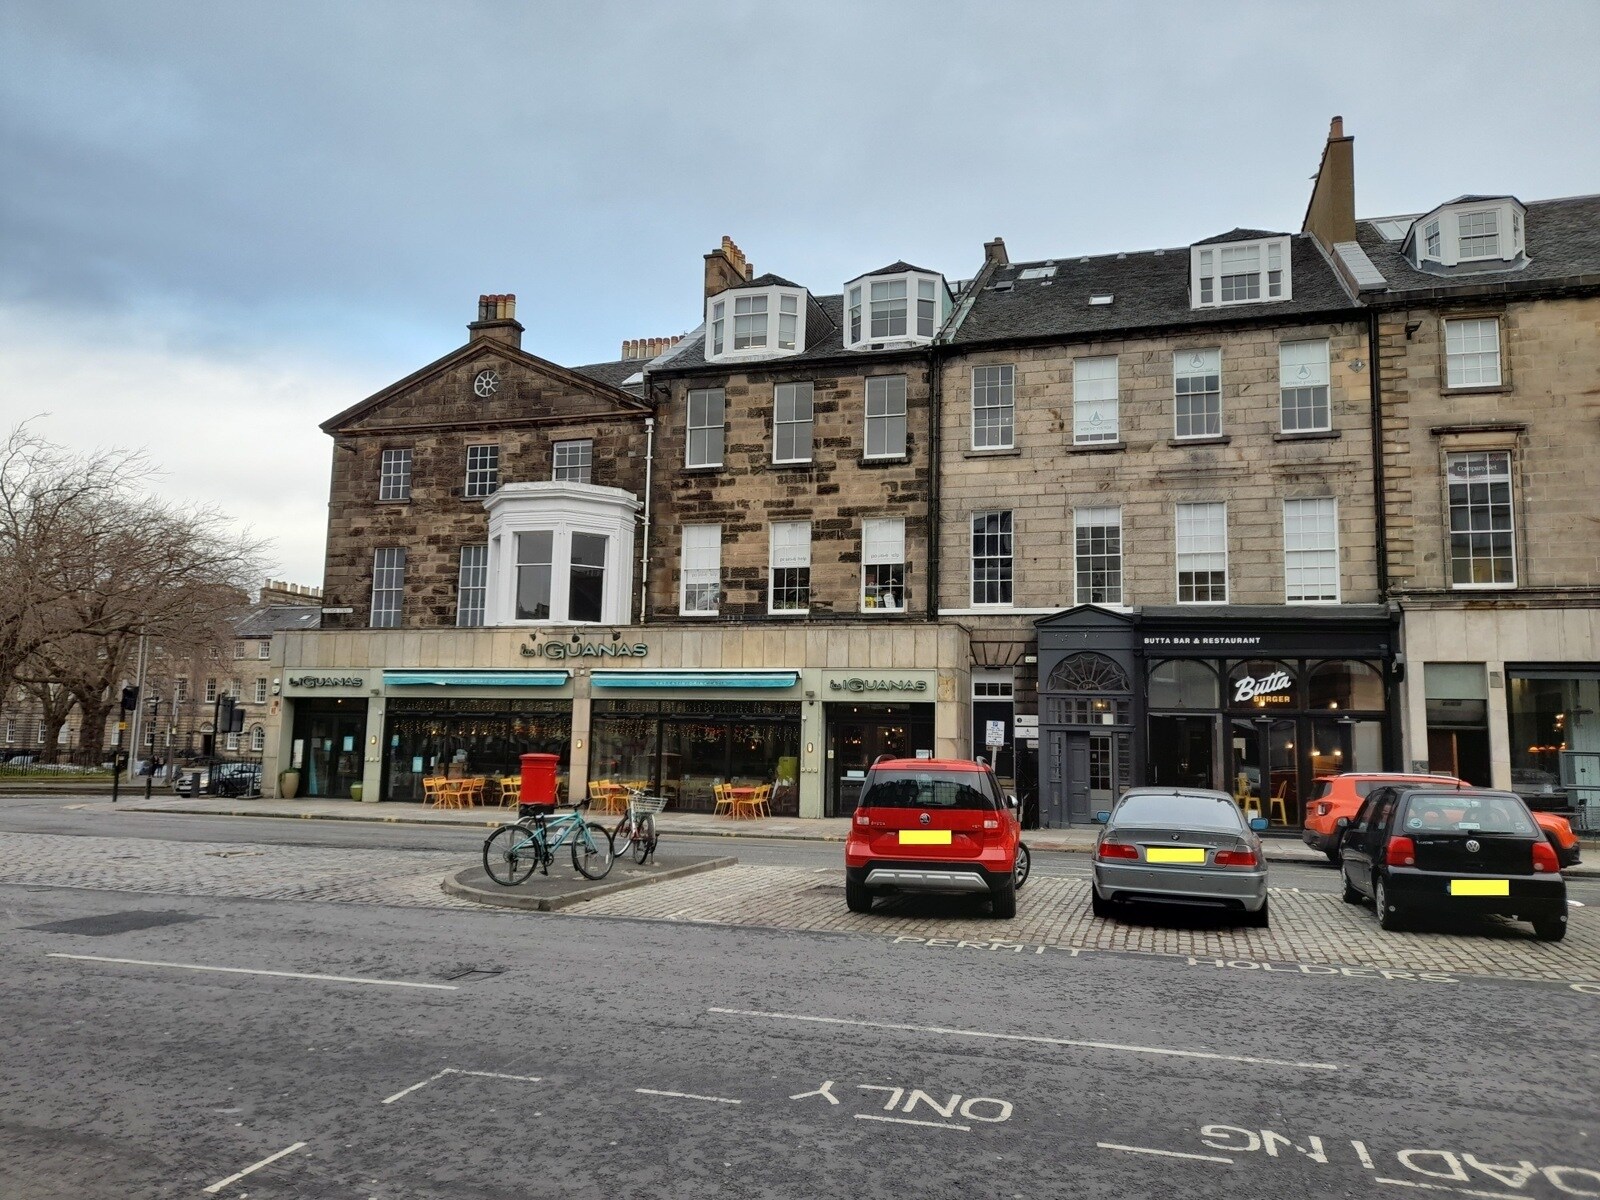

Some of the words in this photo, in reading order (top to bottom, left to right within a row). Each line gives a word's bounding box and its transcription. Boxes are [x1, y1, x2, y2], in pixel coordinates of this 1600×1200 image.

[537, 640, 648, 660] IGUANAS
[299, 675, 363, 689] IGUANAS
[842, 677, 928, 693] IGUANAS
[1234, 670, 1292, 702] Butta
[1253, 695, 1291, 703] BURGER
[892, 936, 1095, 957] PERMIT
[1187, 957, 1460, 984] HOLDERS
[789, 1080, 1014, 1122] ONLY
